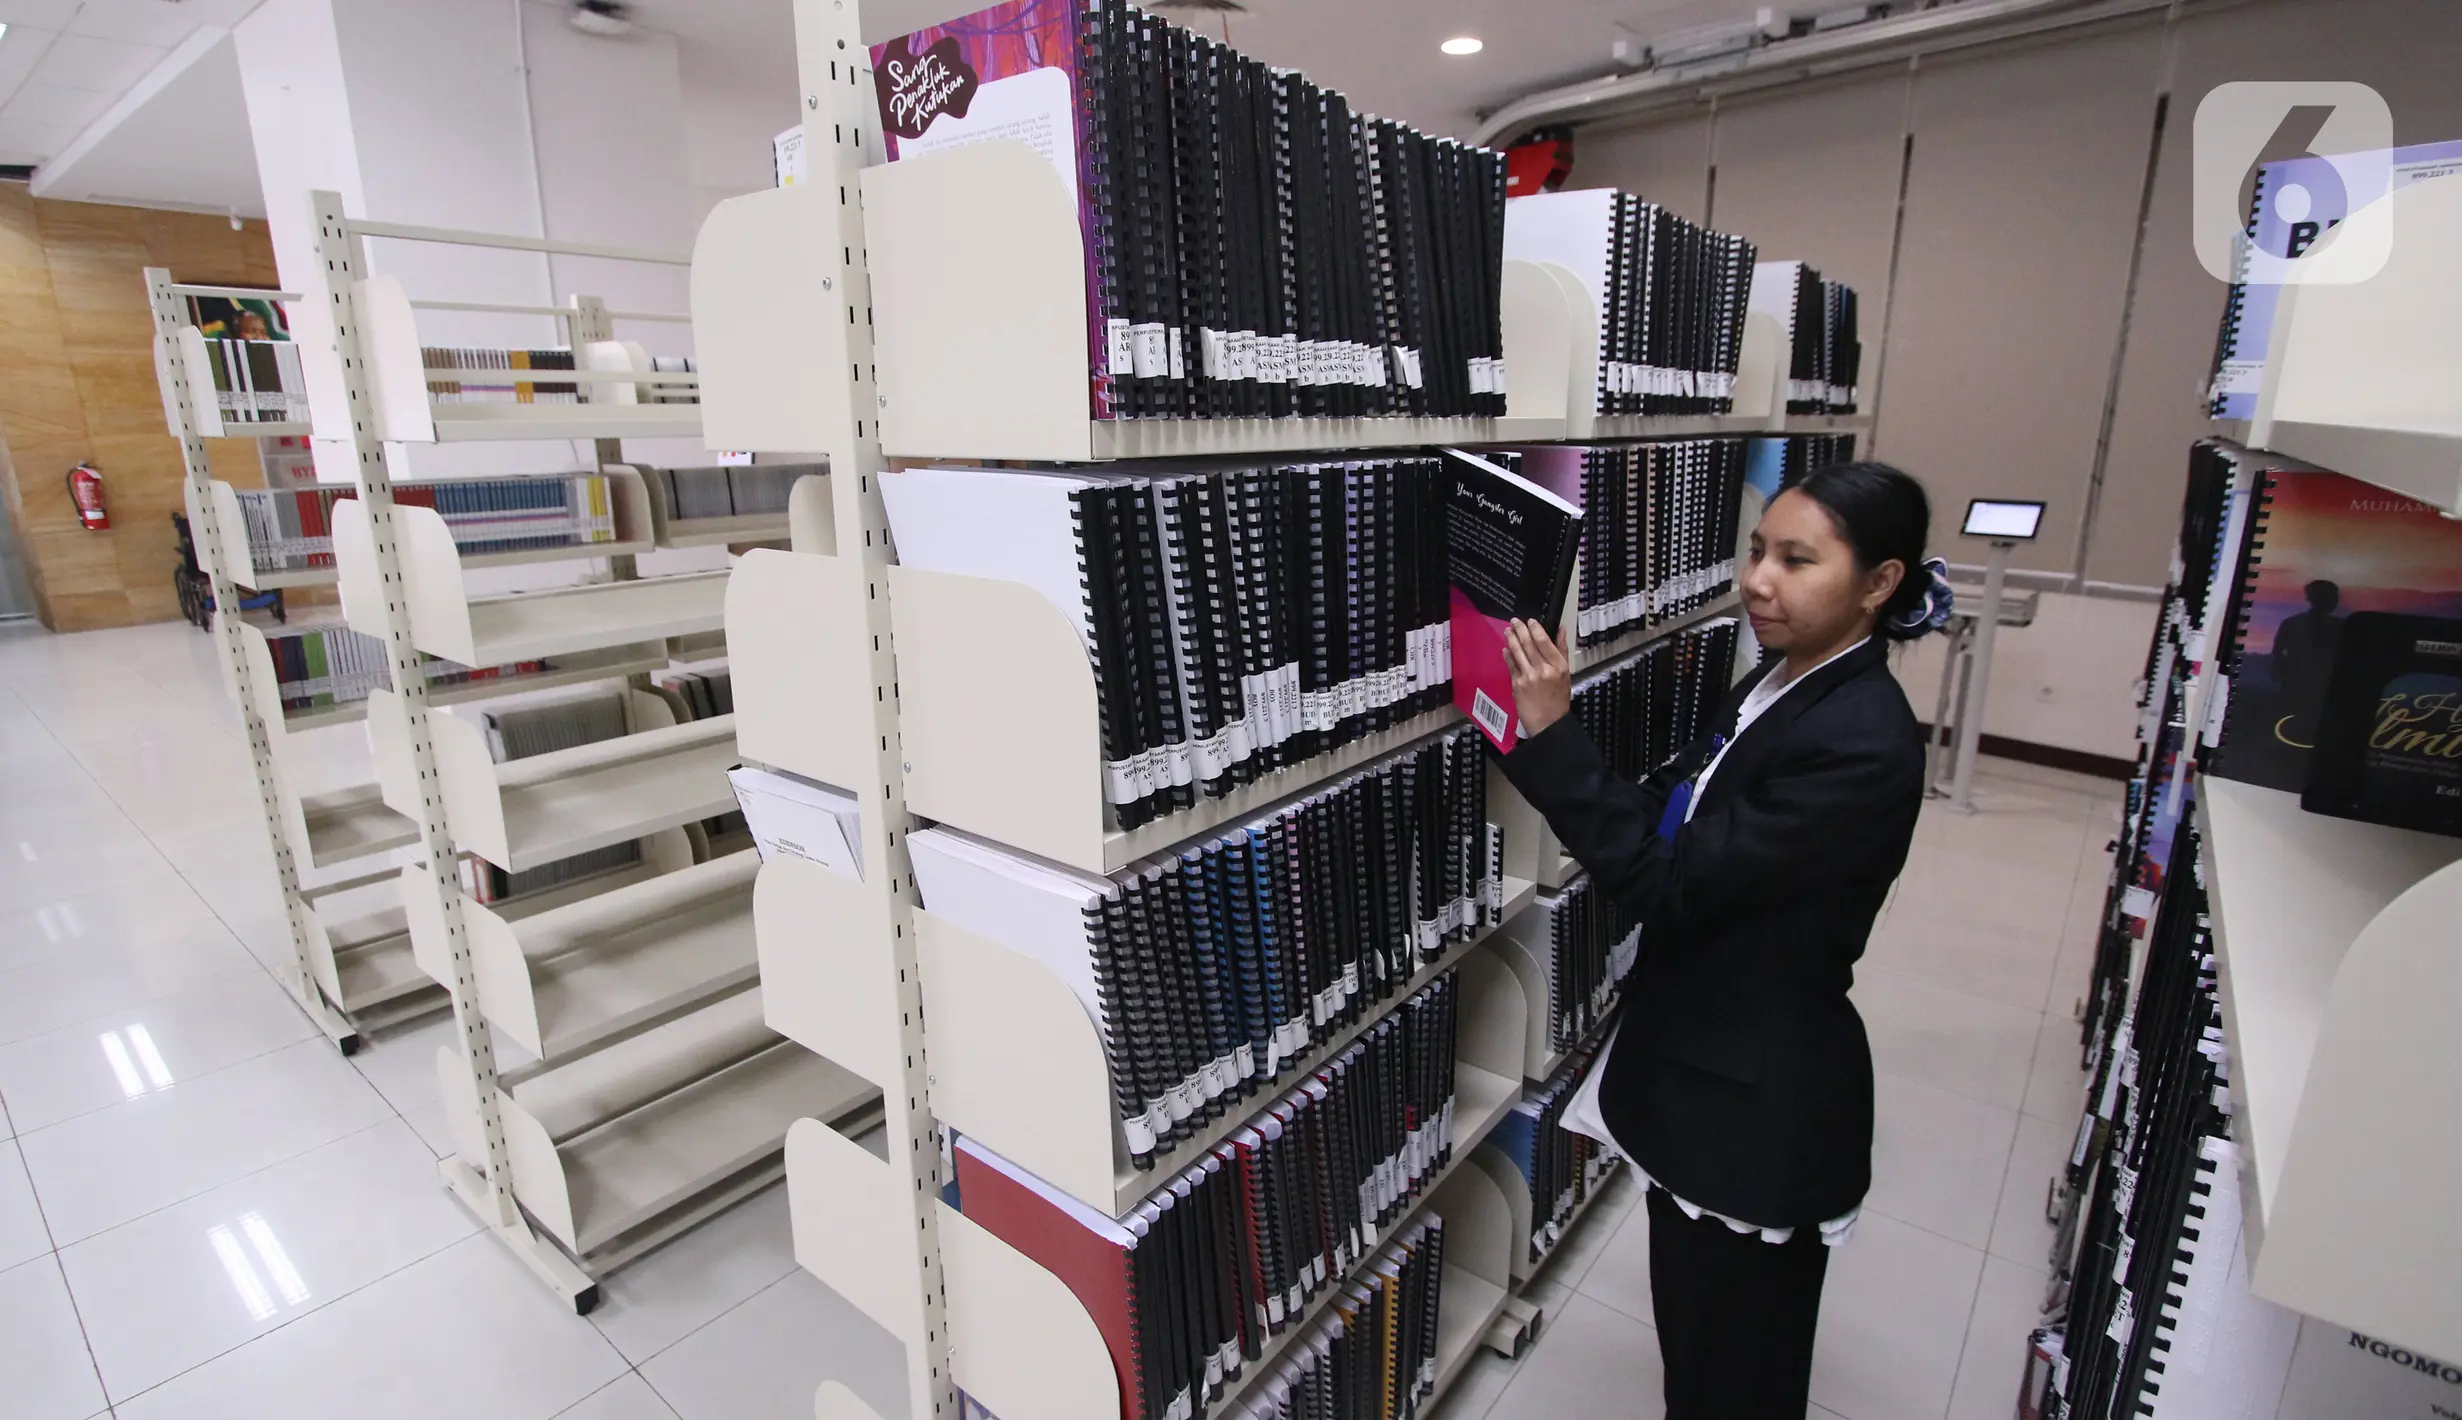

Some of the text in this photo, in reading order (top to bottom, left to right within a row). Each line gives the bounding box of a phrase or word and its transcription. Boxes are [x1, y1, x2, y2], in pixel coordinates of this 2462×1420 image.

[888, 54, 937, 93] Sang
[890, 64, 950, 127] Penakluk
[910, 75, 965, 131] Kutukan
[1476, 493, 1505, 515] Gangster
[1507, 510, 1523, 525] Girl
